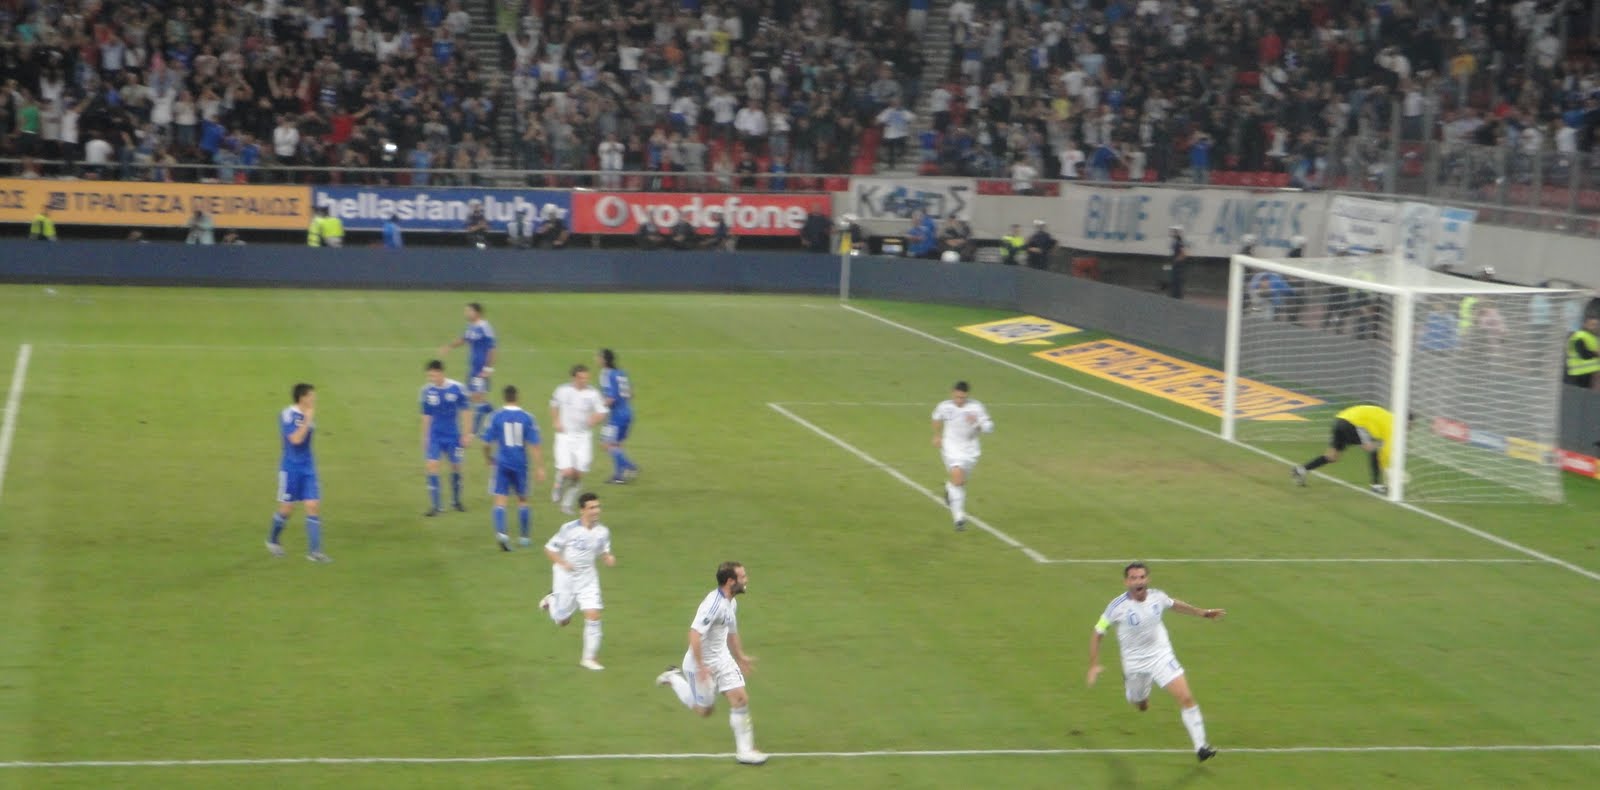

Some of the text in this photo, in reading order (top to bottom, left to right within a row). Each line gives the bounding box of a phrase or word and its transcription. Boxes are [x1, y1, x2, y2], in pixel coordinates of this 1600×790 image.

[73, 192, 186, 212] ΤΡΑΠΕΖΑ
[1084, 194, 1151, 242] BLUE
[503, 421, 524, 448] 11
